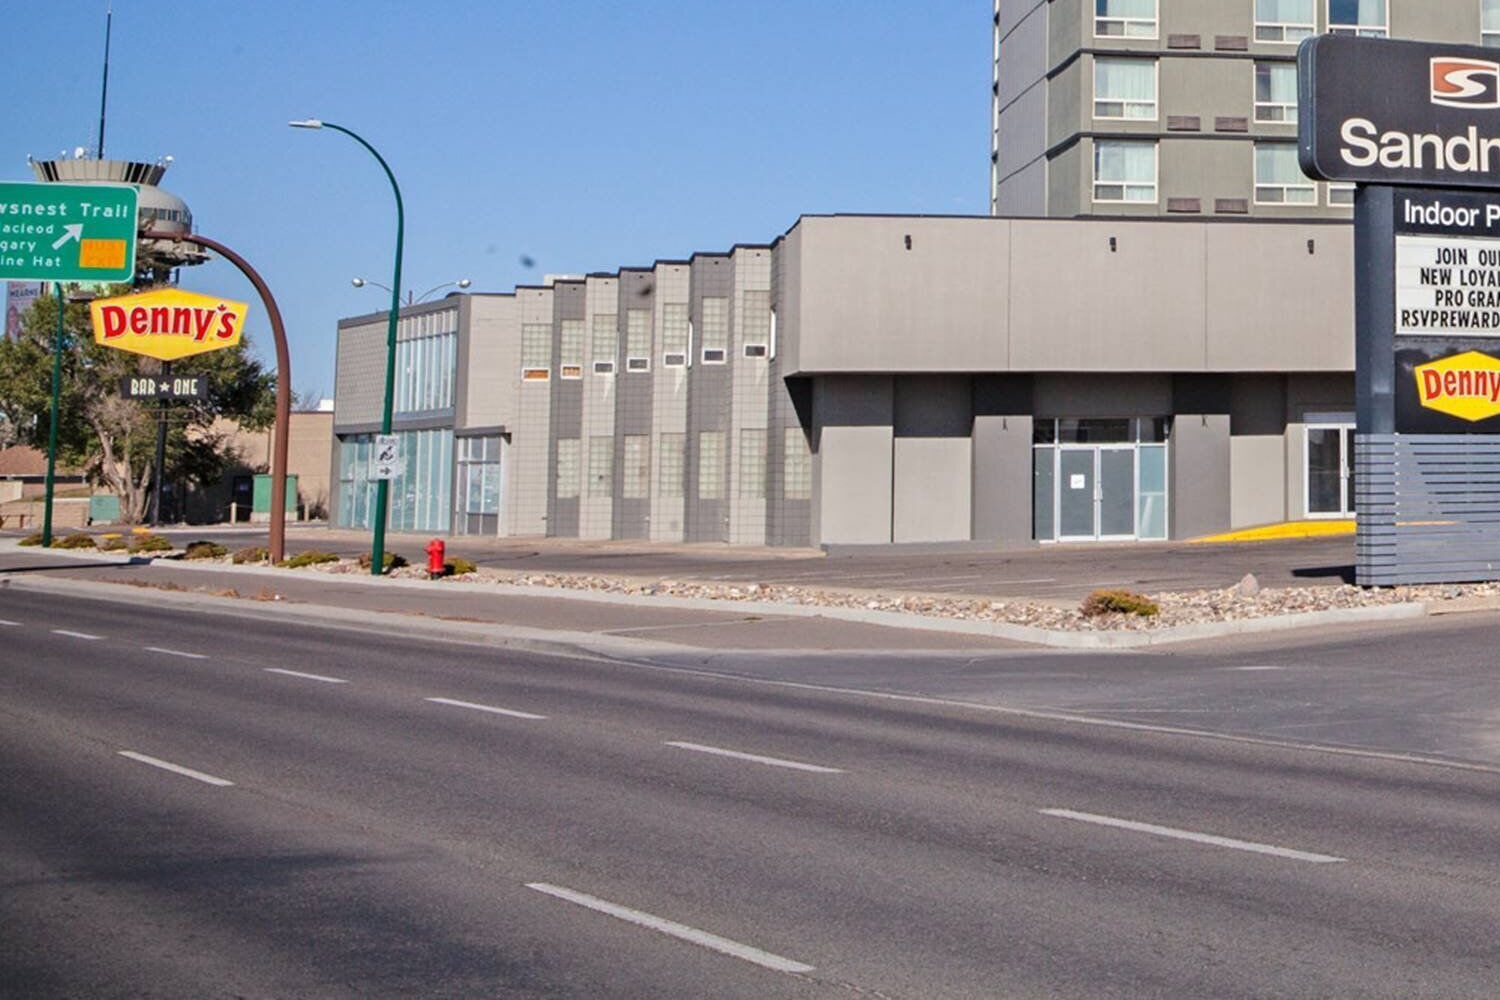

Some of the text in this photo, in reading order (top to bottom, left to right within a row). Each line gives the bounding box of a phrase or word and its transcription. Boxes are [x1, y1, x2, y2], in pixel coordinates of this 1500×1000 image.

[80, 203, 128, 218] Trail
[1404, 199, 1480, 227] Indoor
[3, 222, 54, 234] acleod
[0, 240, 36, 253] gary
[33, 256, 60, 267] Hat
[1435, 248, 1468, 265] JOIN
[1420, 268, 1452, 286] NEW
[101, 304, 236, 341] Denny's
[130, 378, 198, 395] BAR ONE
